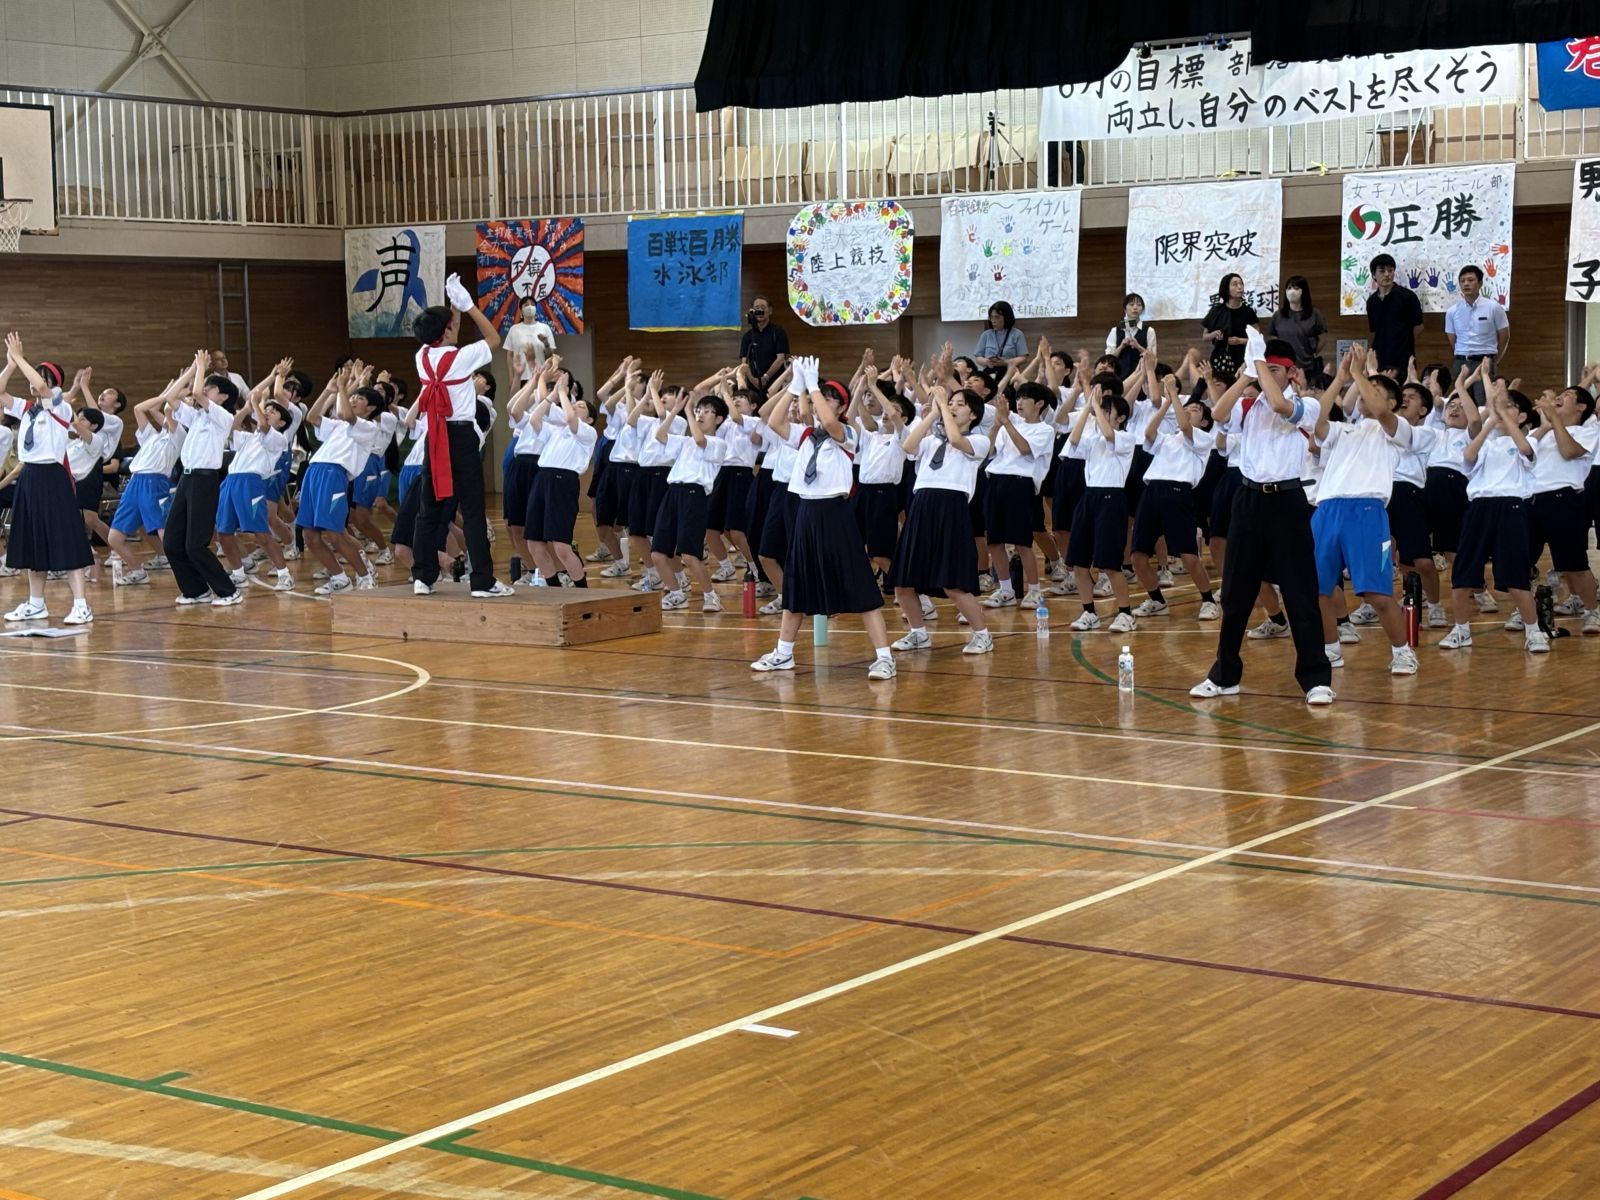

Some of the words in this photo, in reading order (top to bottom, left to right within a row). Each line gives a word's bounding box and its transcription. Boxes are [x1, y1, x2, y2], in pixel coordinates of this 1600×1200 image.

[1107, 50, 1498, 134] 両立し、自分のベストを尽くそう
[1381, 192, 1483, 247] 圧勝
[648, 222, 741, 257] 百戦百勝
[810, 243, 888, 274] 陸上競技
[1155, 229, 1264, 267] 限界突破
[366, 236, 417, 312] 声
[653, 256, 729, 287] 水泳部
